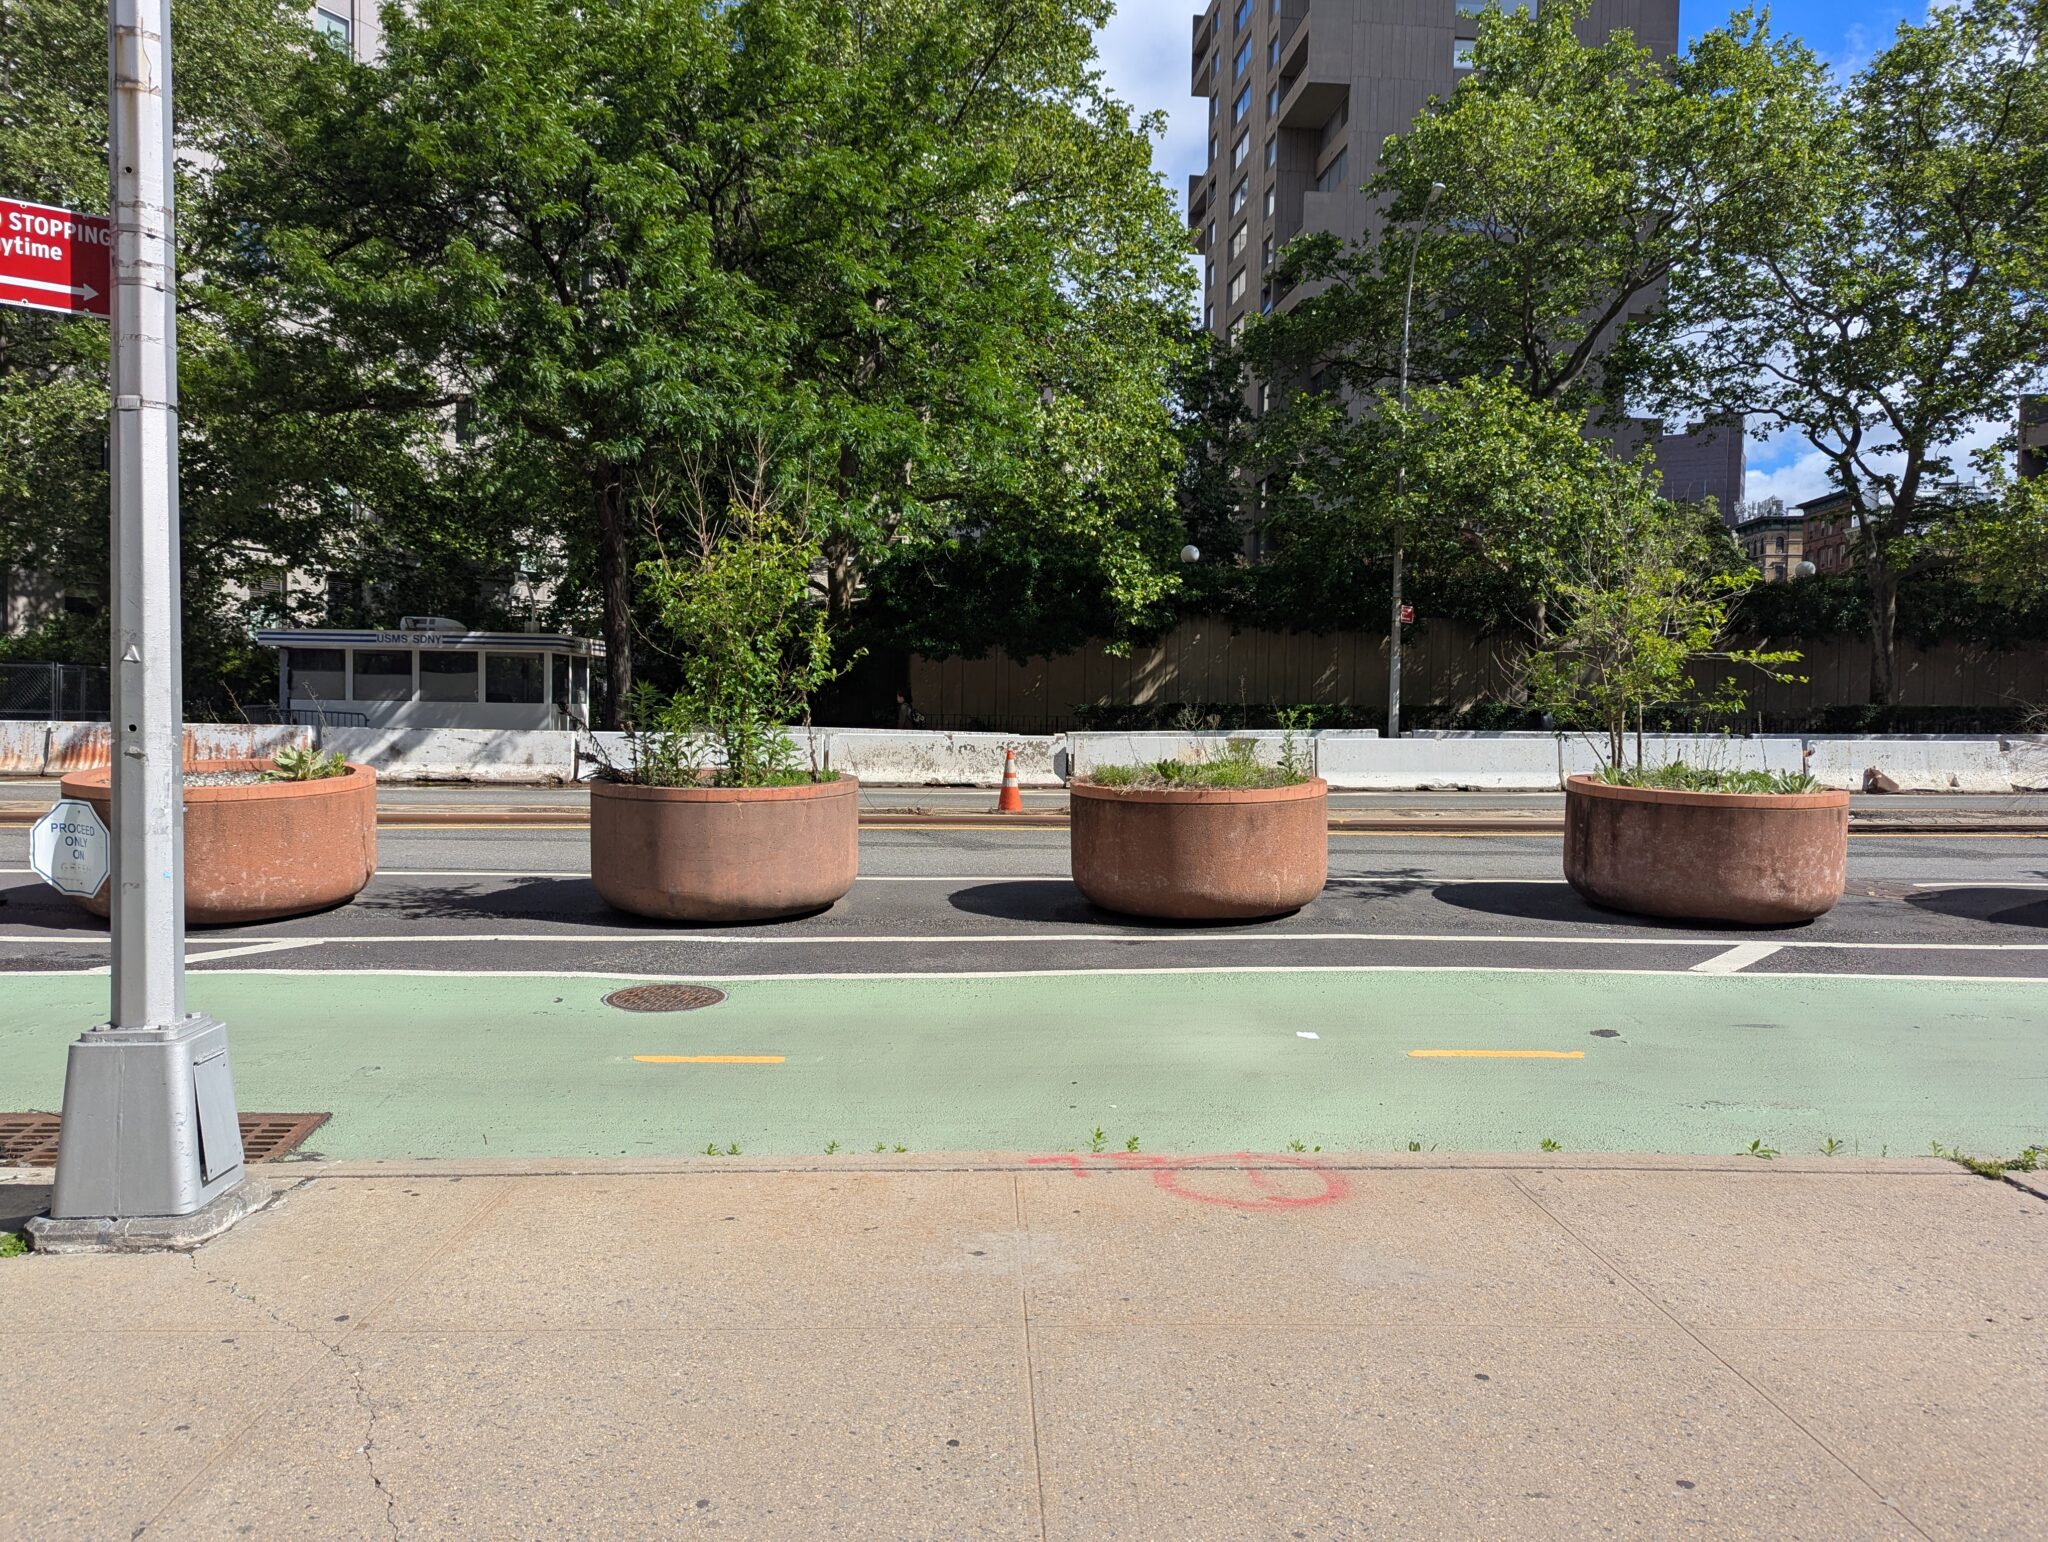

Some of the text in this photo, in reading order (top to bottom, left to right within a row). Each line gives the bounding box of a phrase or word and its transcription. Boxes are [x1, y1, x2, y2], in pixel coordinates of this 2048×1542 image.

[9, 211, 110, 245] STOPPING
[377, 634, 442, 644] USMS SDNY
[50, 822, 95, 836] PROCEED
[65, 836, 88, 848] ONLY
[72, 849, 85, 860] ON
